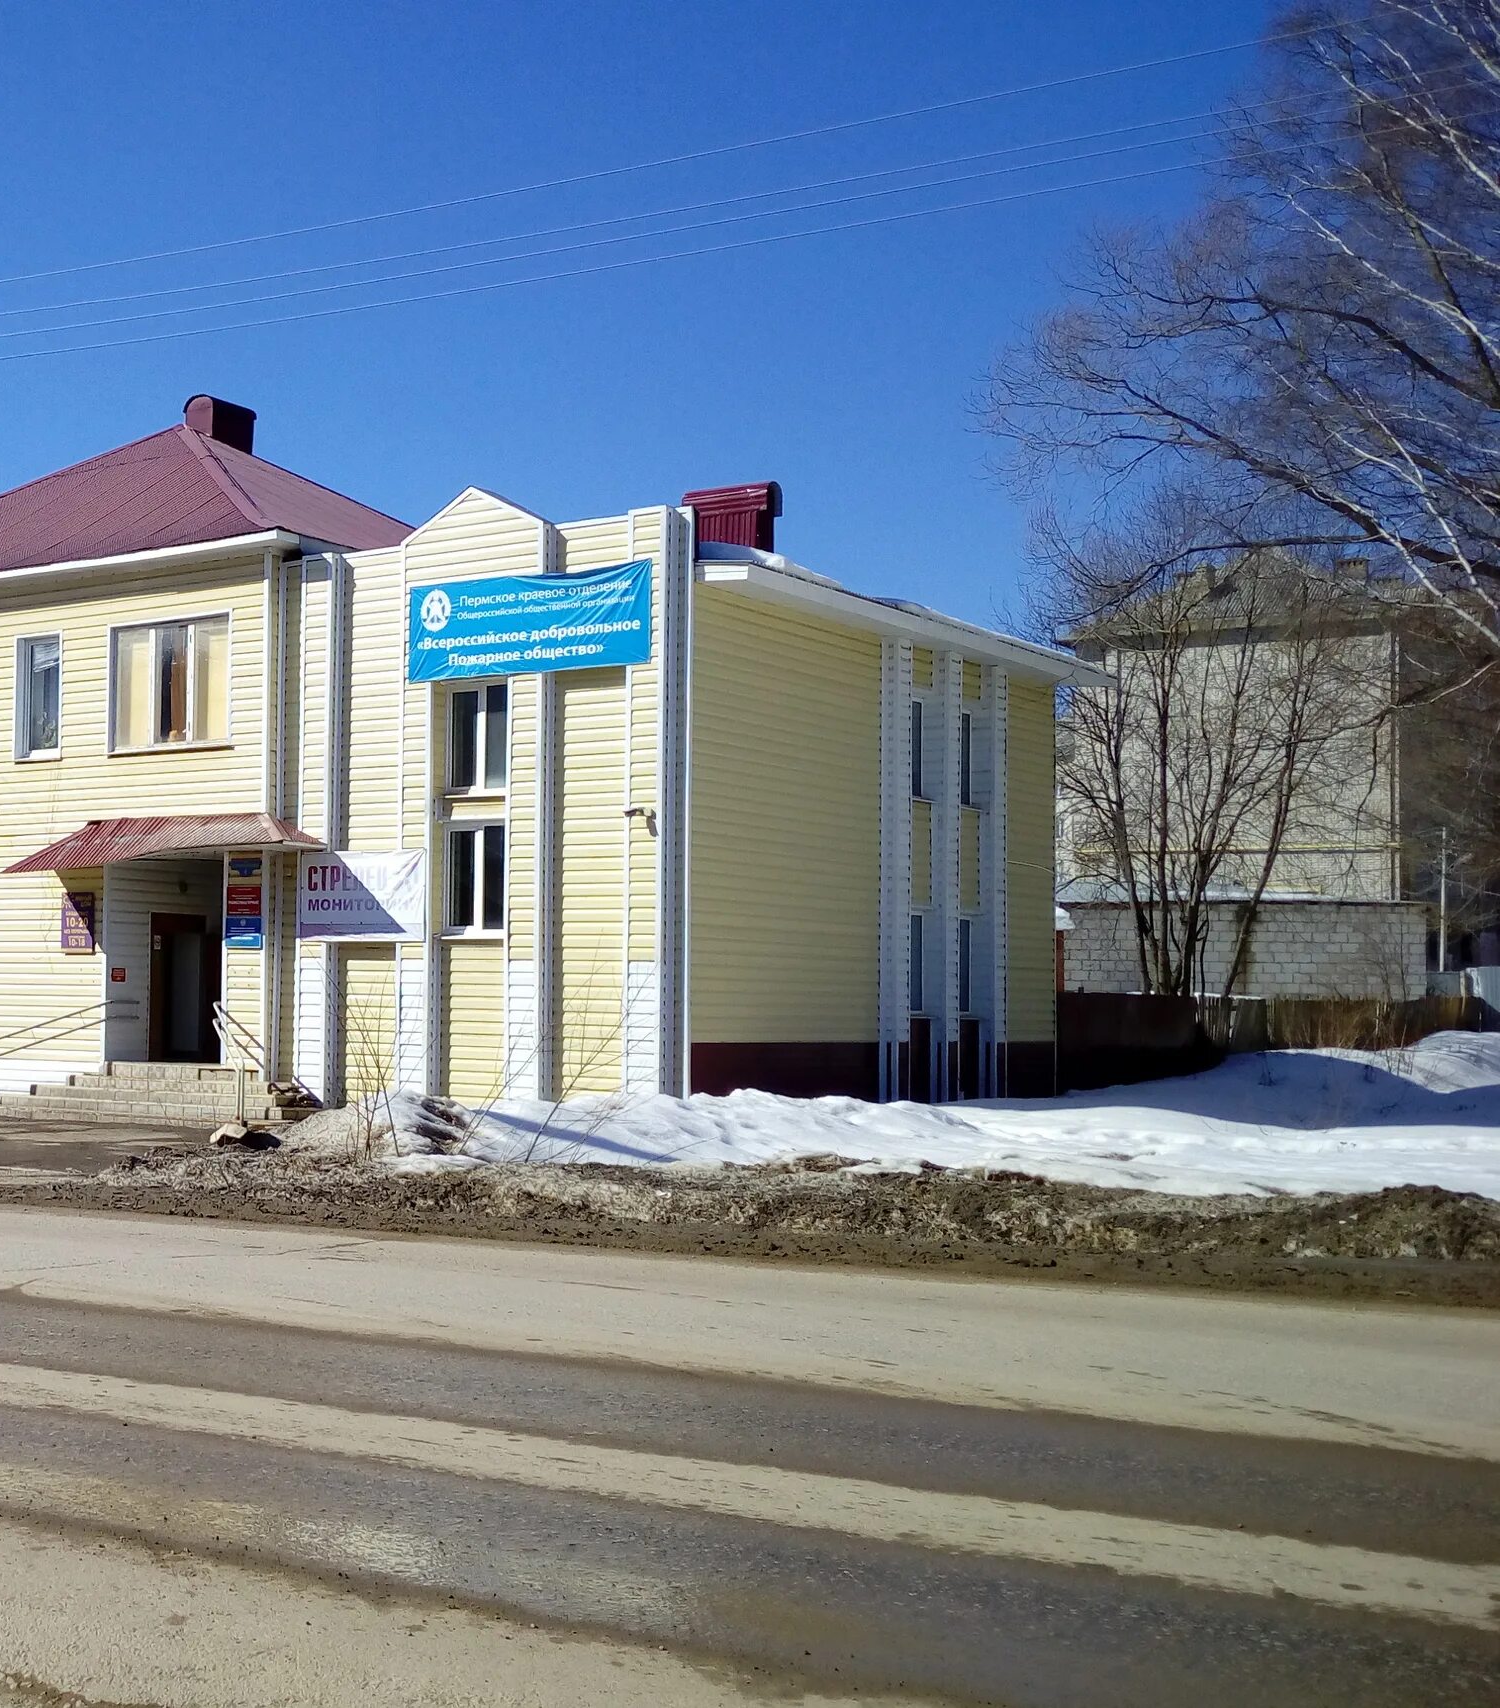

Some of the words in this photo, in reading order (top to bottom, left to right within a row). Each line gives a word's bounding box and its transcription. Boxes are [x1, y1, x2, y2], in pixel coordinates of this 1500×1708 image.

[459, 592, 516, 609] Пермское
[518, 587, 566, 603] краевое
[568, 579, 633, 596] отделение
[457, 605, 522, 620] Общероссийской
[523, 600, 581, 615] общественной
[416, 630, 528, 651] «Всероссийское
[529, 619, 641, 643] добровольное
[448, 650, 521, 667] Пожарное
[523, 643, 604, 660] общество»
